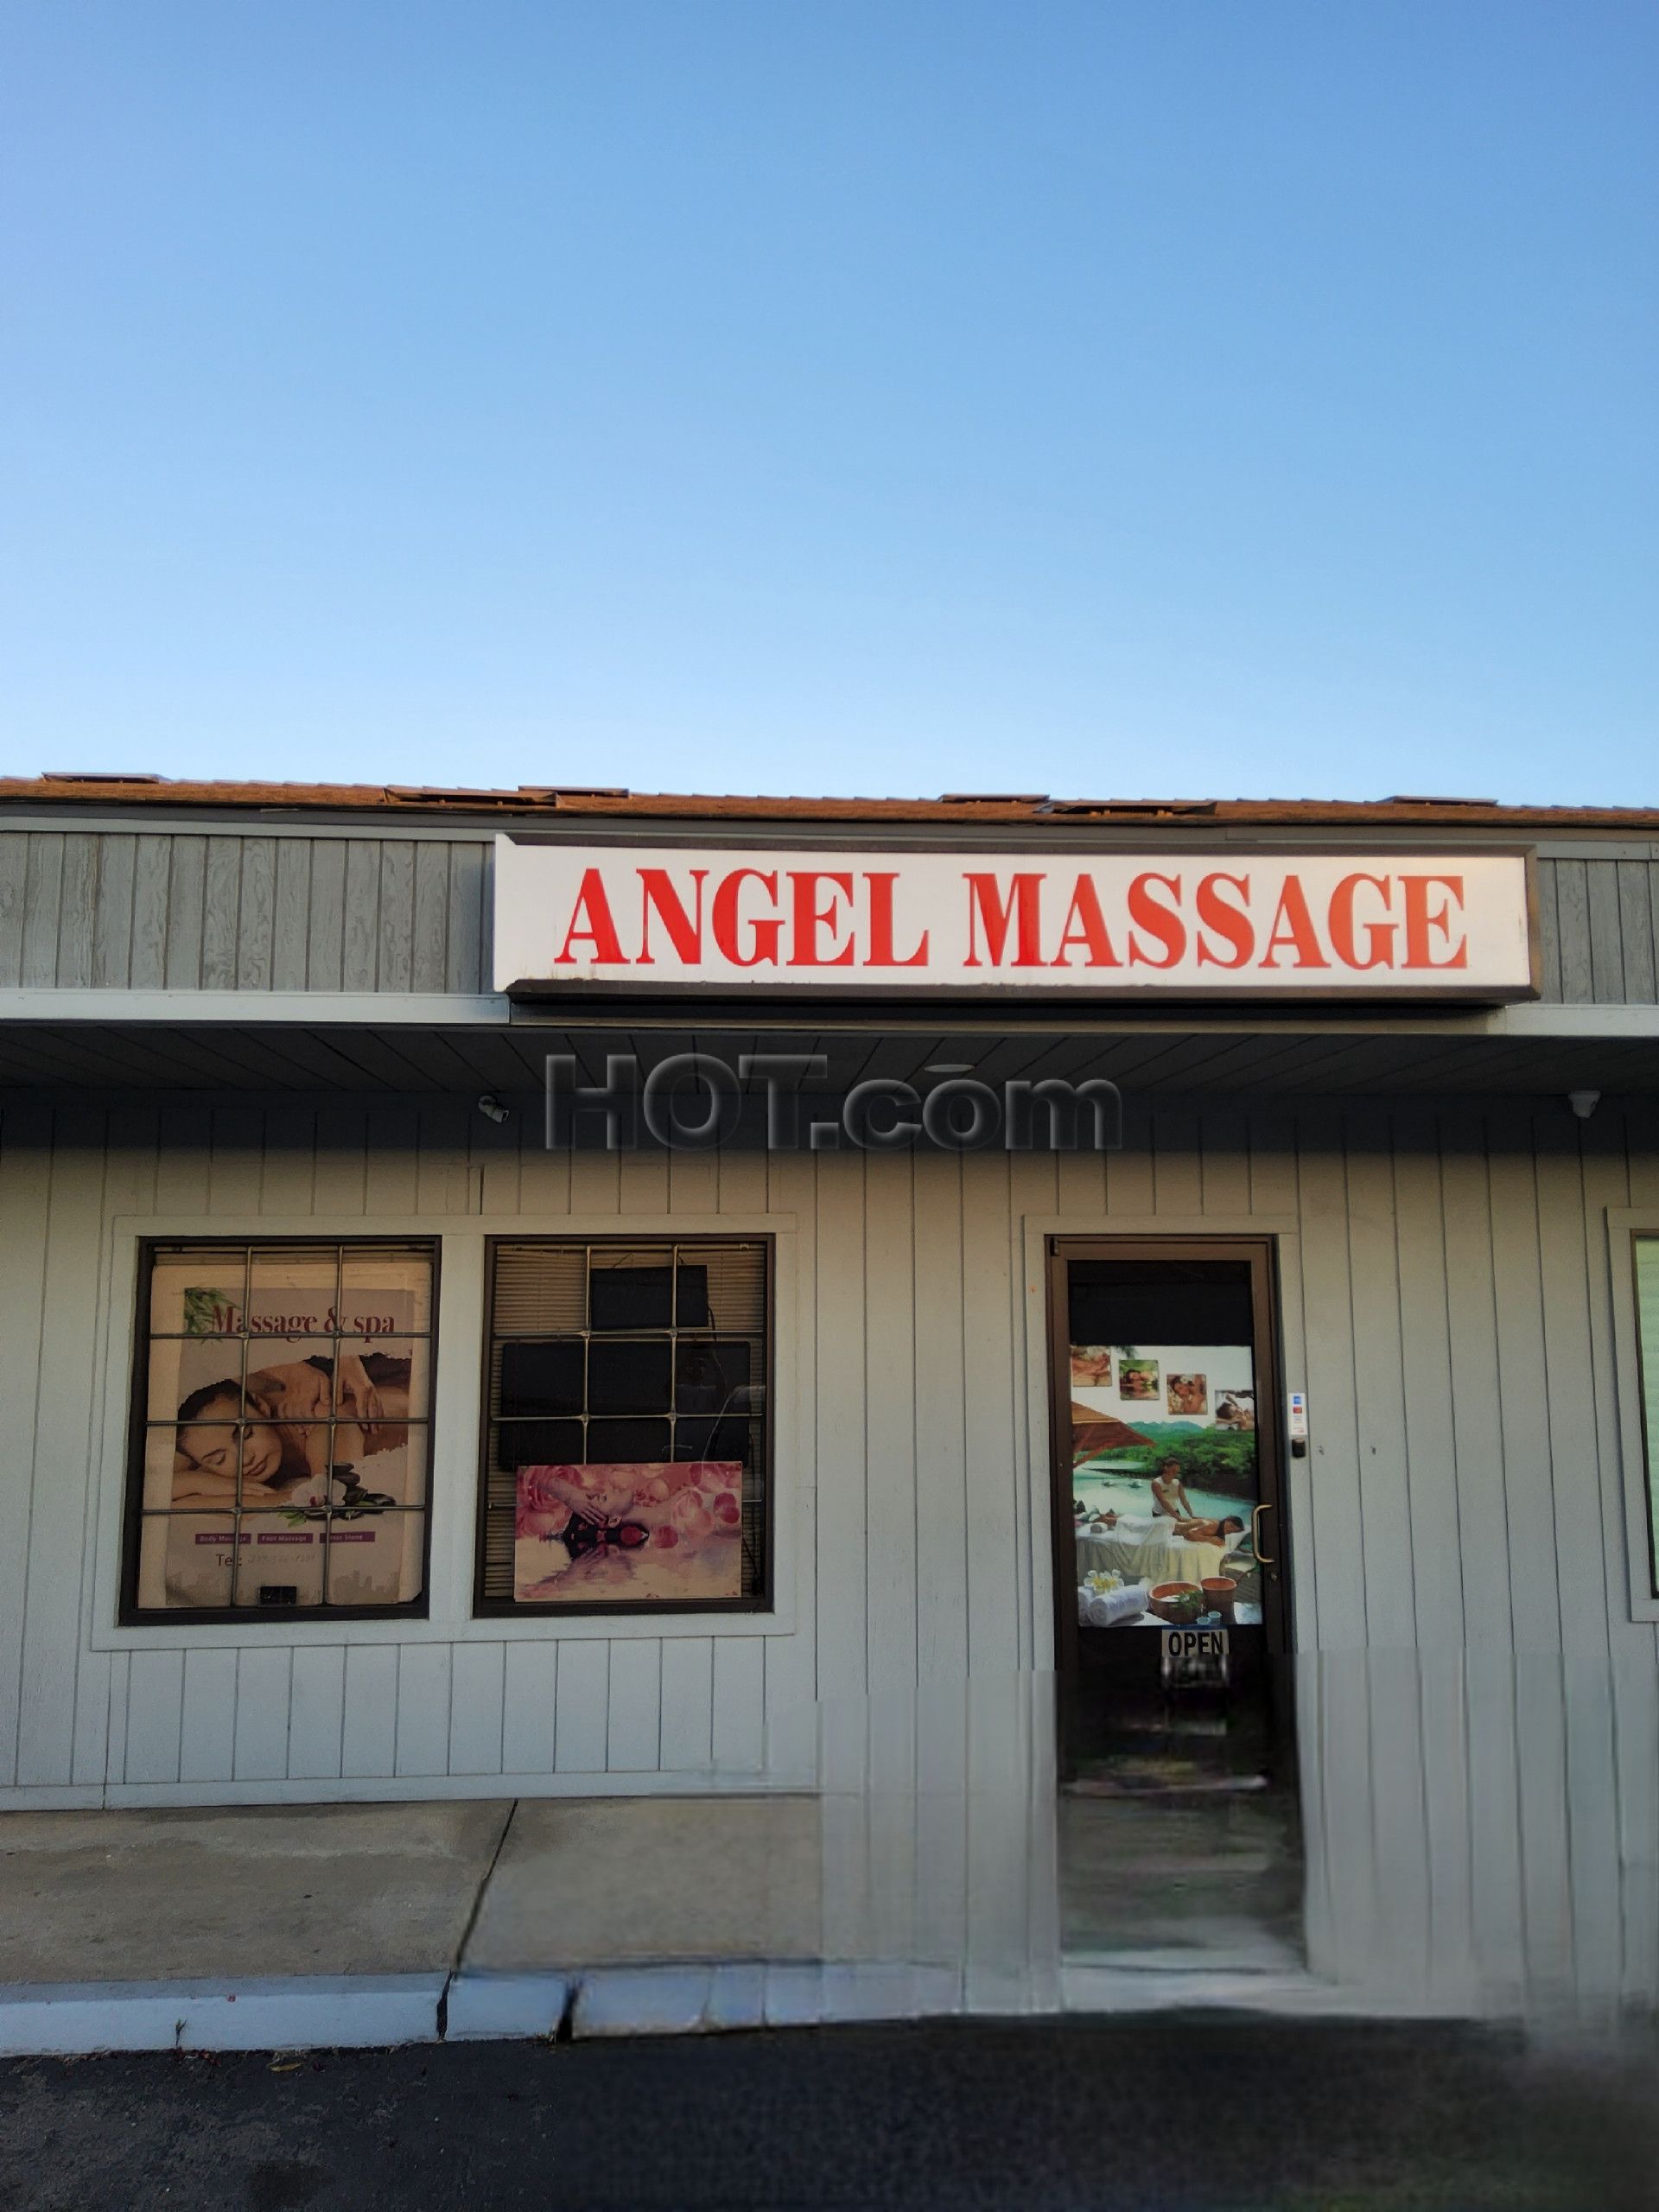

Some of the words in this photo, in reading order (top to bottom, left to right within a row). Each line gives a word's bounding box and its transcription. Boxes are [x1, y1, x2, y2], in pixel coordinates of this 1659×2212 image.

[554, 868, 929, 967] ANGEL
[962, 872, 1467, 970] MASSAGE
[212, 1306, 317, 1343] Massage
[354, 1314, 395, 1344] spa
[216, 1554, 242, 1567] Te:
[1168, 1630, 1224, 1656] OPEN
